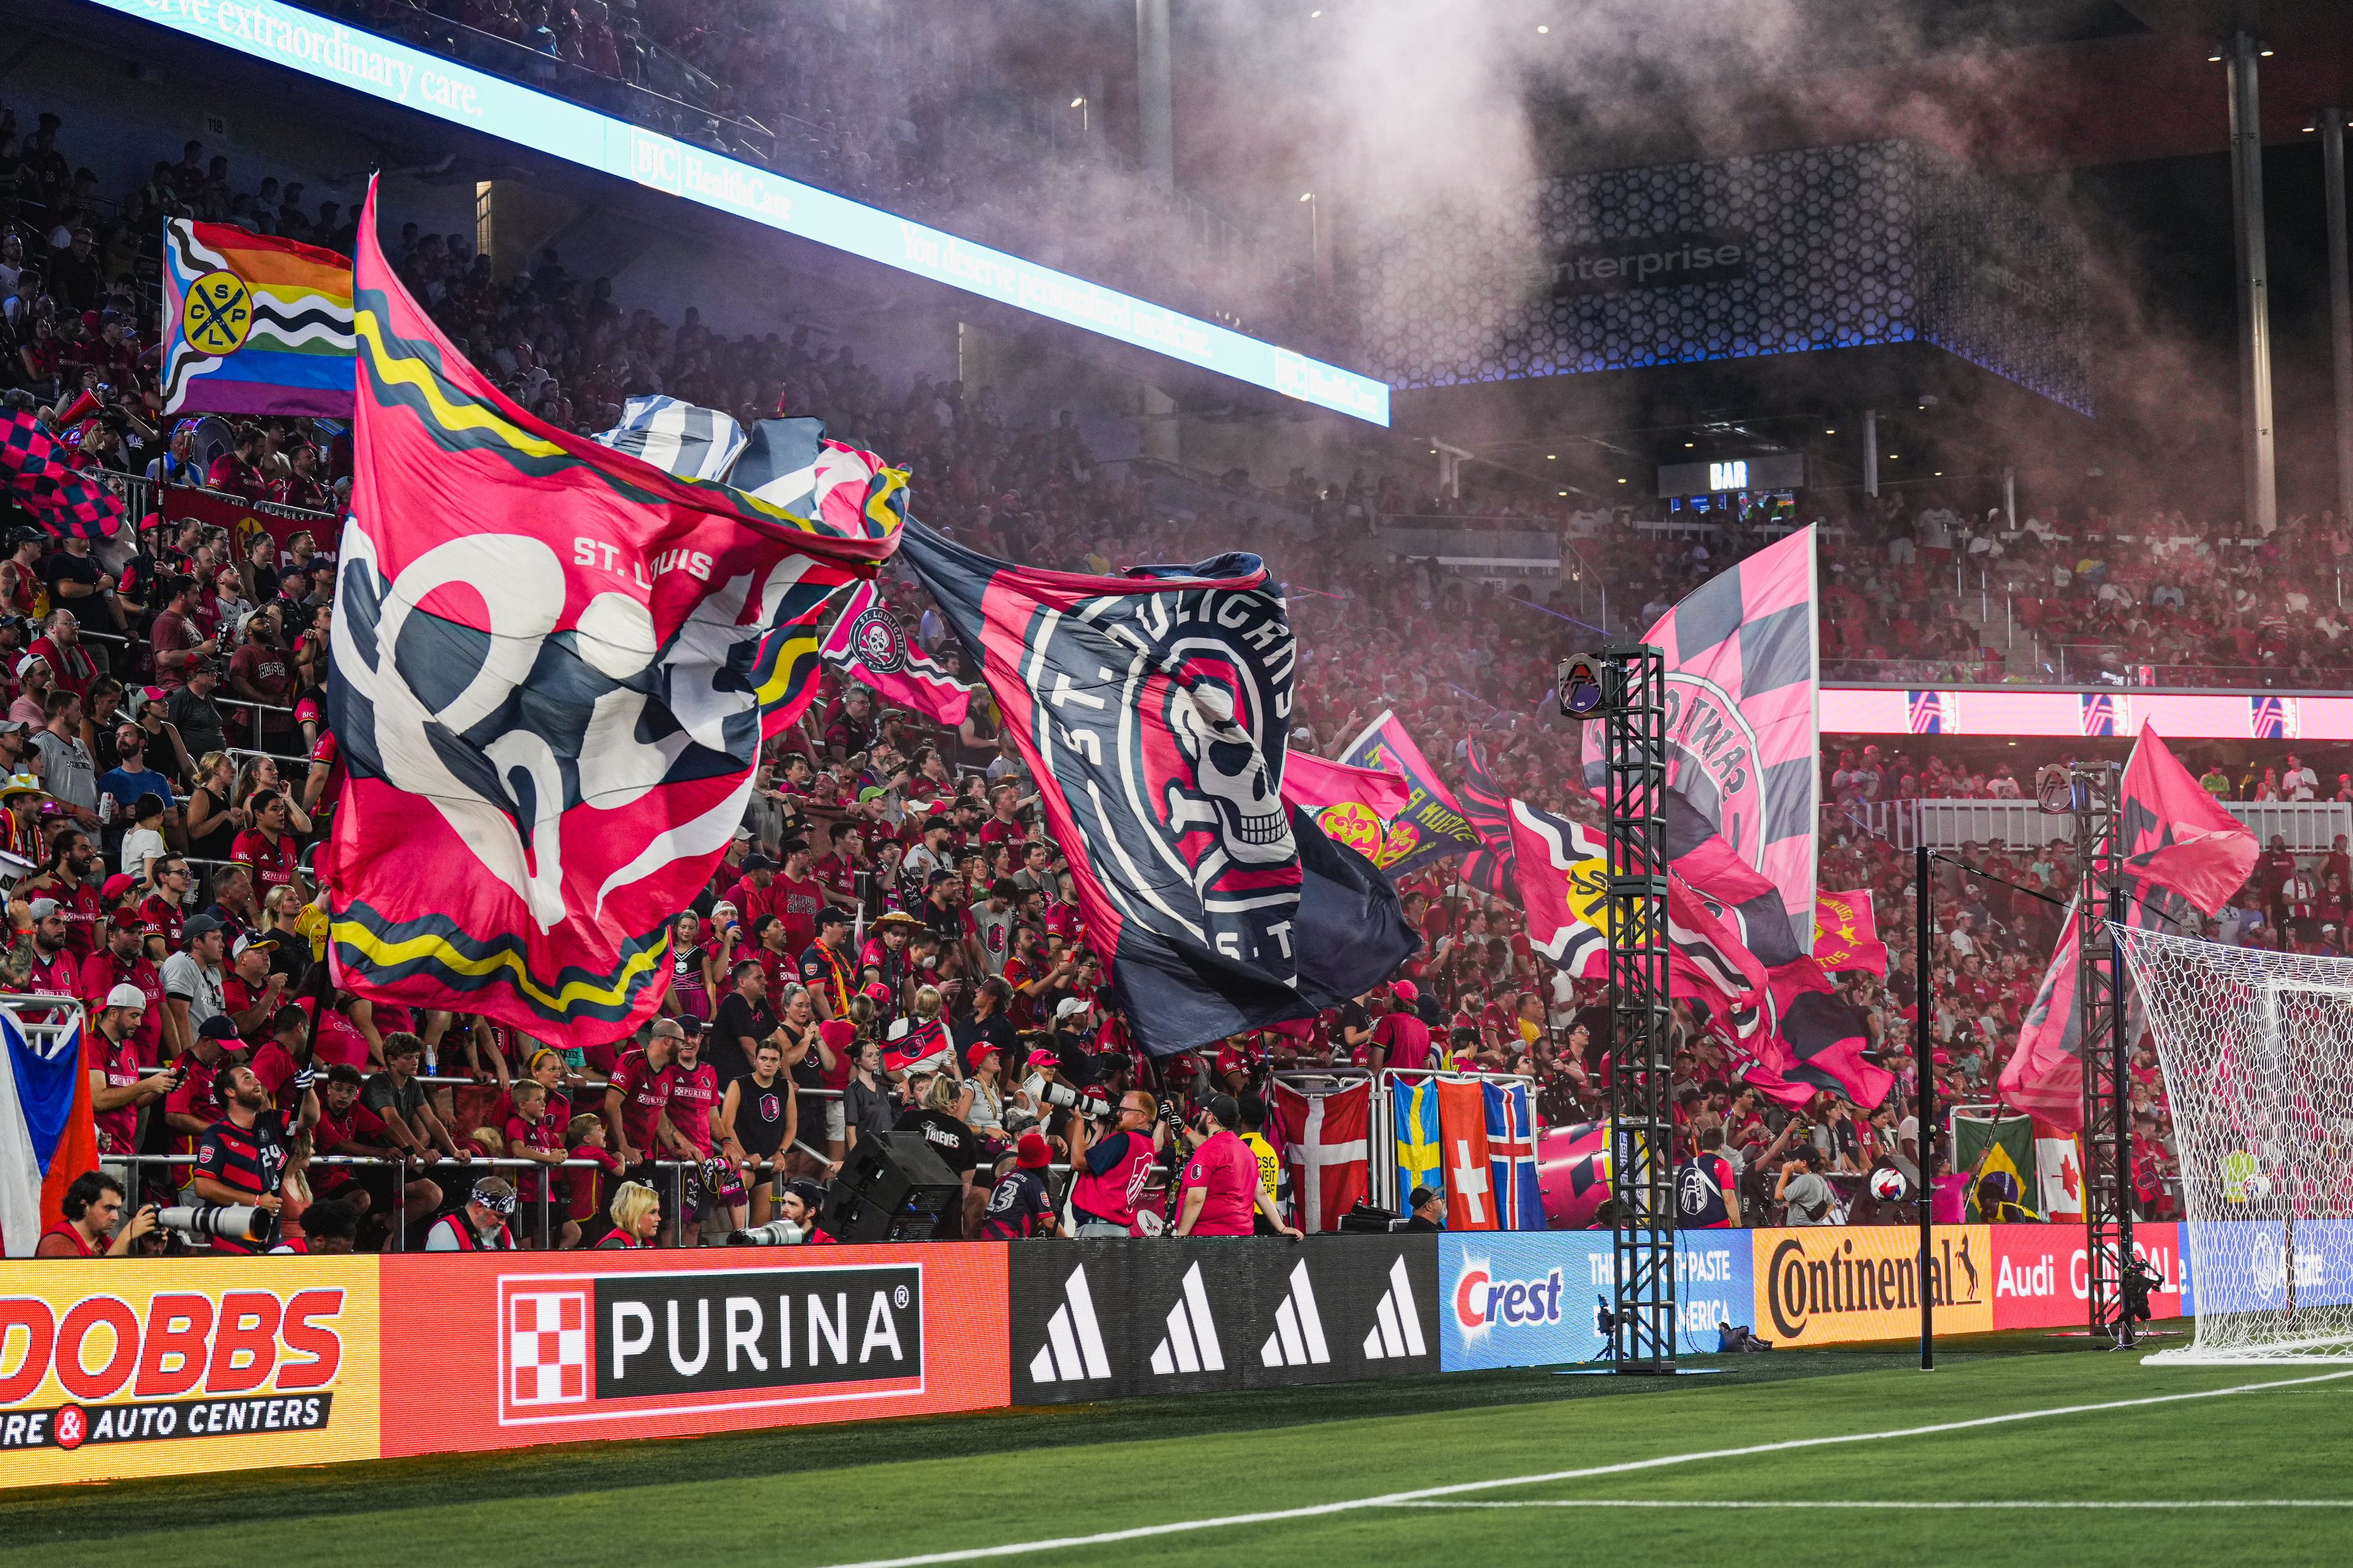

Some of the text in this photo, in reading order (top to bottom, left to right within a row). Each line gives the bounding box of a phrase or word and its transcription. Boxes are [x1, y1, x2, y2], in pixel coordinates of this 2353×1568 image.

[217, 1, 414, 101] extraordinary
[420, 69, 483, 117] care.
[207, 118, 223, 134] 118
[637, 140, 792, 220] BJC HealthCare
[898, 220, 939, 270] You
[947, 237, 1016, 296] deserve
[214, 284, 229, 299] S
[190, 304, 247, 323] C P
[208, 329, 223, 345] L
[210, 477, 221, 486] BJC
[1710, 461, 1747, 491] BAR
[573, 536, 625, 577] ST.
[859, 613, 871, 624] ST.
[787, 903, 805, 913] CITY
[798, 895, 817, 905] LOUIS
[146, 923, 161, 931] BJC
[869, 954, 880, 964] BJC
[1103, 1042, 1115, 1050] BJC
[611, 1071, 625, 1083] BJC
[683, 1088, 711, 1099] PURINA
[925, 1129, 960, 1148] THIEVES
[722, 1182, 740, 1193] 2023
[1695, 1177, 1704, 1203] CITY
[1638, 1249, 1731, 1285] TOTHPASTE
[1996, 1254, 2055, 1298] Audi
[1767, 1235, 1954, 1339] Continenal
[1456, 1270, 1562, 1327] Crest
[1676, 1299, 1730, 1333] MERICA
[611, 1290, 904, 1380] PURINA
[0, 1289, 346, 1408] DOBBS
[0, 1398, 322, 1445] RE & AUTO CENTERS
